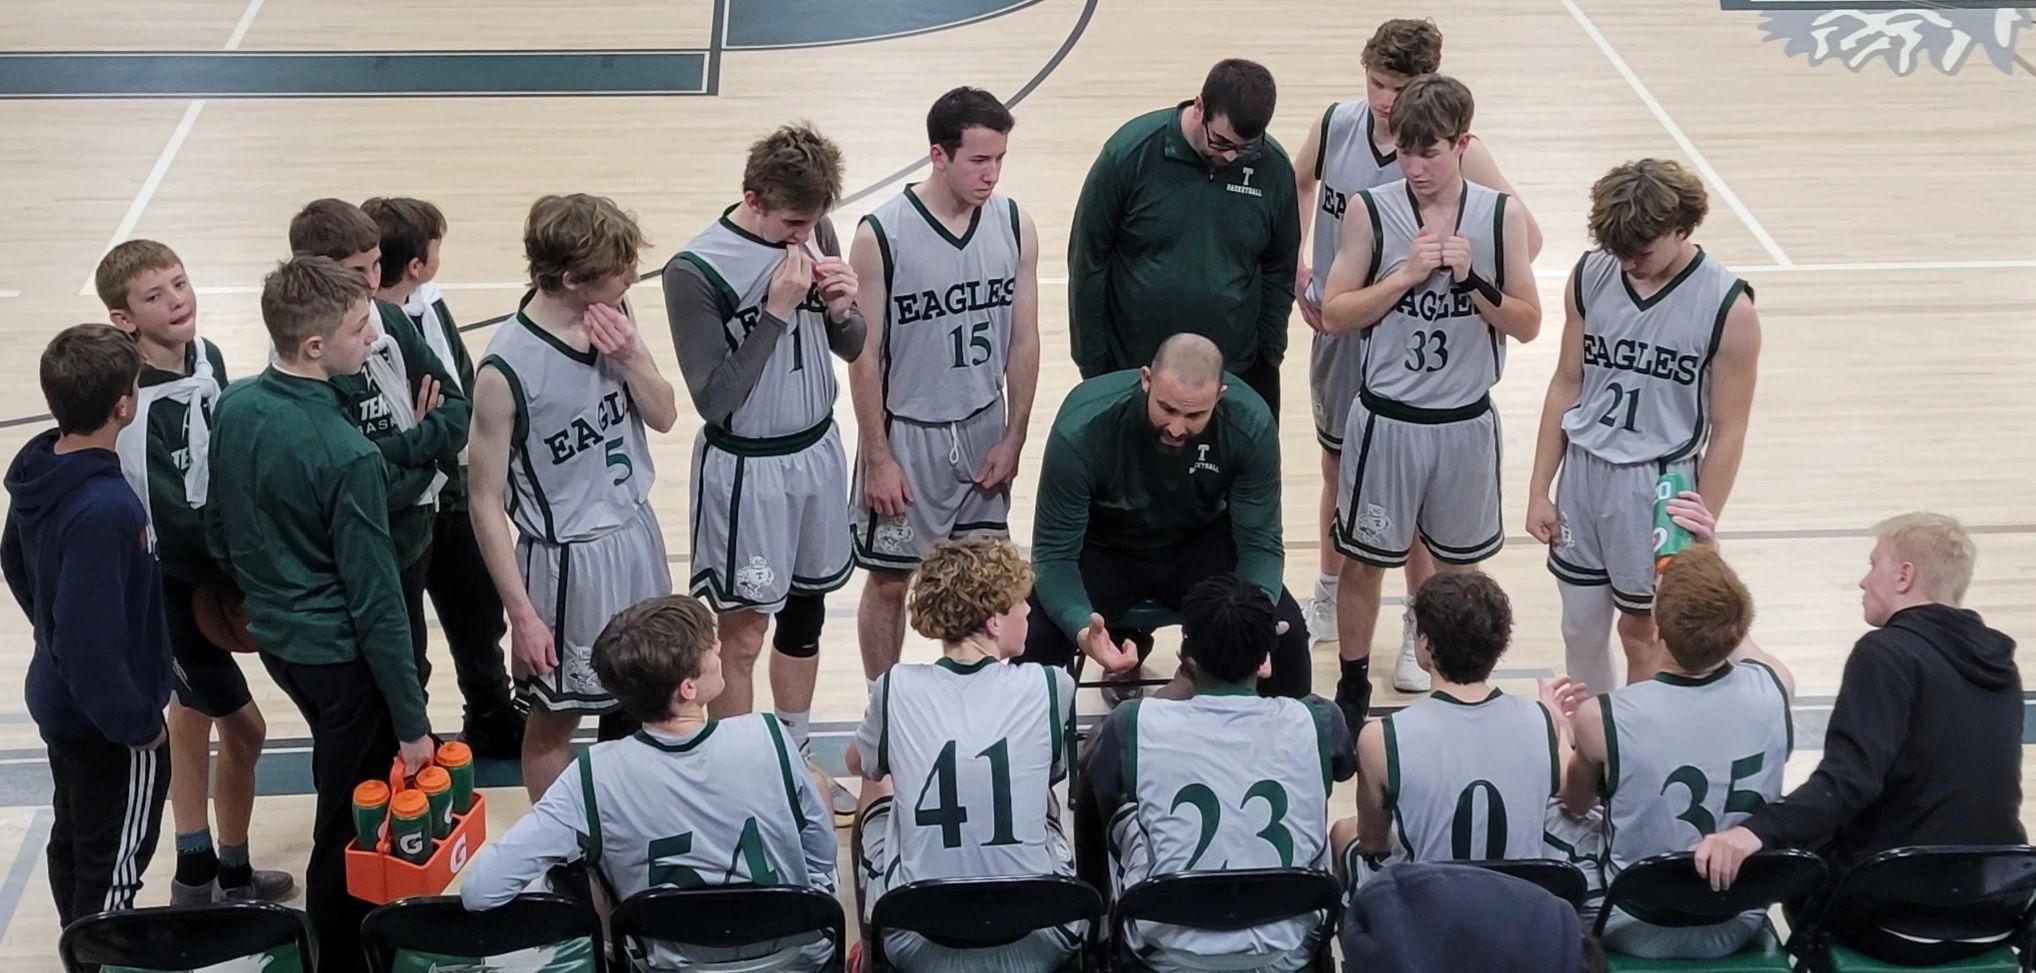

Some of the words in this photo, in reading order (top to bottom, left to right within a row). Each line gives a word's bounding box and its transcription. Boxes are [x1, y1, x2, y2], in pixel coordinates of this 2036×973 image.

[1243, 167, 1254, 186] T
[893, 277, 1015, 325] EAGLES
[1395, 287, 1481, 322] AGLE
[789, 324, 804, 374] 1
[948, 321, 992, 369] 15
[1404, 329, 1449, 373] 33
[1583, 333, 1699, 386] EAGLES
[543, 391, 629, 465] EAGL
[1598, 382, 1642, 433] 21
[604, 436, 633, 487] 5
[1197, 444, 1210, 461] T
[914, 736, 1023, 849] 41
[1659, 750, 1769, 840] 35
[399, 831, 424, 855] G
[1169, 779, 1294, 872] 23
[1451, 779, 1508, 861] 0
[450, 831, 468, 874] G
[648, 815, 779, 888] 54
